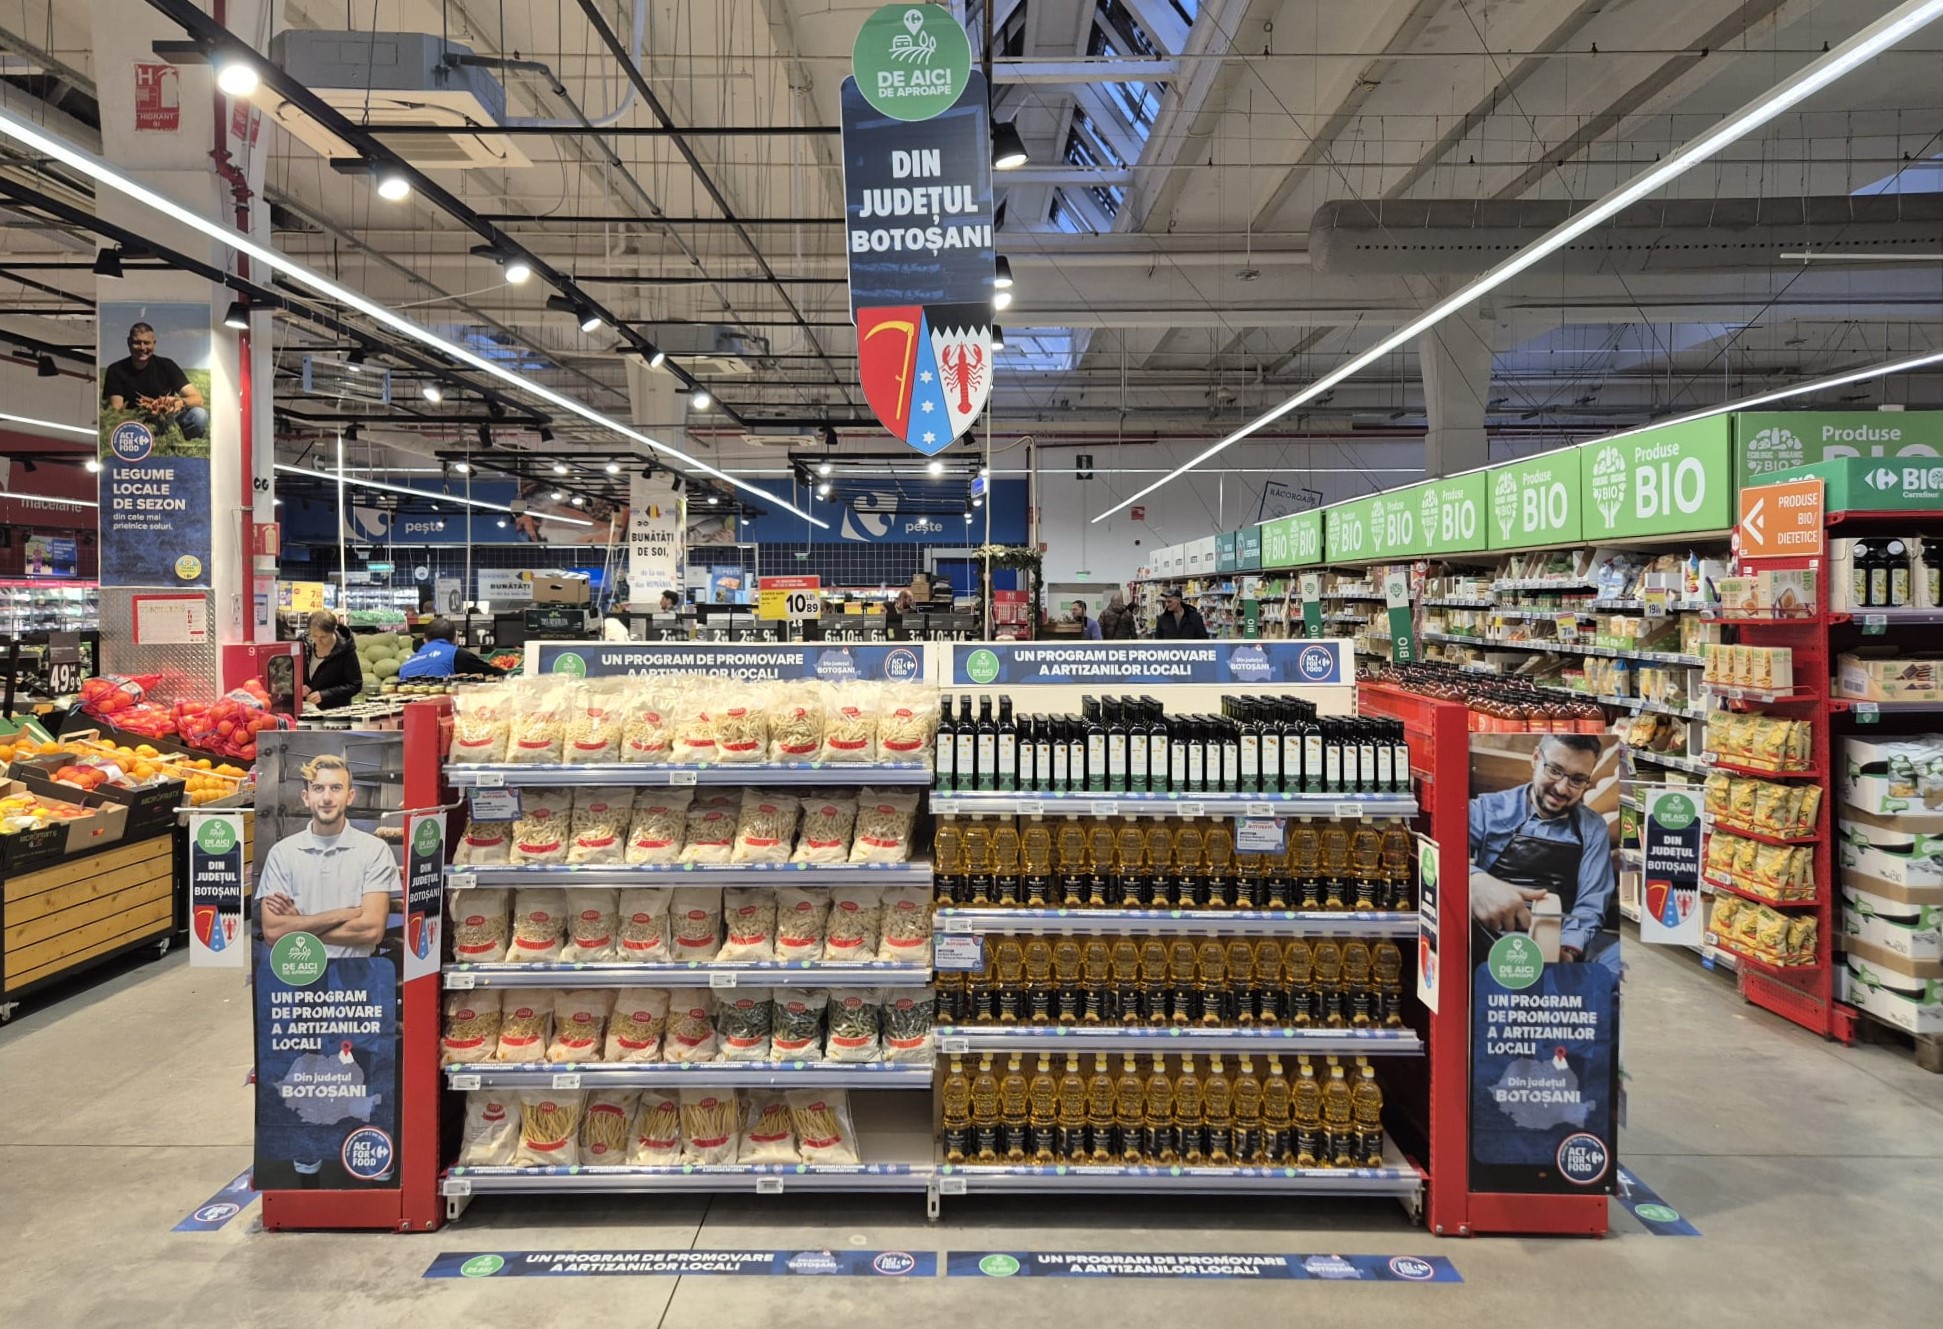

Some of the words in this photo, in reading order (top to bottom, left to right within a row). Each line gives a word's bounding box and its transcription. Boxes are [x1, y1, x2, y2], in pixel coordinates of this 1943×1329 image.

[138, 68, 152, 85] H
[877, 70, 905, 88] DE
[910, 68, 951, 87] AICI
[878, 87, 894, 98] DE
[897, 85, 951, 97] APROAPE
[892, 149, 941, 178] DIN
[859, 185, 978, 225] JUDEȚUL
[851, 225, 992, 257] BOTOȘANI
[1822, 425, 1902, 441] Produse
[1635, 442, 1680, 463] Produse
[113, 469, 174, 480] LEGUME
[1522, 469, 1551, 486] Produse
[113, 484, 170, 495] LOCALE
[1635, 457, 1706, 518] BIO
[1443, 488, 1463, 501] Produse
[1778, 493, 1818, 508] PRODUSE
[113, 498, 133, 510] DE
[137, 498, 186, 510] SEZON
[1523, 482, 1568, 532] BIO
[113, 512, 125, 521] din
[128, 513, 144, 521] cele
[147, 513, 161, 521] mai
[1442, 499, 1475, 541] BIO
[1797, 511, 1817, 526] BIO/
[113, 522, 148, 531] prielnice
[1387, 511, 1413, 547] BIO
[1300, 528, 1316, 556] BIO
[1342, 521, 1363, 552] BIO
[1777, 530, 1818, 545] DIETETICE
[637, 547, 649, 557] DE
[652, 547, 669, 558] SOI,
[1272, 535, 1287, 559] BIO
[786, 594, 806, 613] 10
[806, 603, 818, 613] 89
[248, 647, 256, 656] 9
[1398, 637, 1410, 658] BIO
[602, 654, 622, 665] UN
[625, 654, 694, 665] PROGRAM
[697, 654, 715, 665] DE
[717, 654, 804, 665] PROMOVARE
[1014, 650, 1035, 662] UN
[1037, 650, 1107, 661] PROGRAM
[1108, 650, 1127, 661] DE
[1129, 650, 1217, 661] PROMOVARE
[1039, 665, 1050, 675] A
[1051, 664, 1142, 675] ARTIZANILOR
[1143, 664, 1192, 675] LOCALI
[50, 664, 70, 693] 49
[1663, 835, 1682, 845] DIN
[1650, 846, 1694, 860] JUDEȚUL
[208, 861, 225, 870] DIN
[420, 863, 432, 874] DIN
[1647, 860, 1697, 875] BOTOȘANI
[196, 872, 237, 884] JUDEȚUL
[411, 873, 439, 887] JUDEȚUL
[194, 886, 240, 900] BOTOȘANI
[409, 887, 440, 903] BOTOȘANI
[298, 962, 318, 970] AICI
[1499, 966, 1514, 974] DE
[1516, 966, 1534, 974] AICI
[271, 992, 292, 1003] UN
[295, 990, 367, 1003] PROGRAM
[1488, 995, 1509, 1007] UN
[1511, 995, 1582, 1008] PROGRAM
[271, 1007, 290, 1019] DE
[292, 1005, 383, 1019] PROMOVARE
[1488, 1011, 1506, 1023] DE
[1508, 1011, 1597, 1024] PROMOVARE
[272, 1023, 282, 1035] A
[288, 1021, 380, 1035] ARTIZANILOR
[1488, 1027, 1498, 1039] A
[1503, 1027, 1595, 1040] ARTIZANILOR
[272, 1037, 322, 1050] LOCALI
[1488, 1042, 1536, 1054] LOCALI
[293, 1073, 312, 1082] Din
[313, 1072, 352, 1085] județul
[1508, 1078, 1526, 1087] Din
[1528, 1077, 1566, 1089] județul
[282, 1085, 366, 1102] BOTOȘANI
[1496, 1090, 1581, 1108] BOTOȘANI
[353, 1141, 371, 1150] ACT
[1568, 1147, 1586, 1156] ACT
[353, 1150, 370, 1159] FOR
[1568, 1155, 1585, 1164] FOR
[352, 1158, 377, 1167] FOOD
[1568, 1163, 1592, 1172] FOOD
[526, 1254, 551, 1263] UN
[549, 1253, 639, 1263] PROGRAM
[641, 1253, 666, 1262] DE
[667, 1253, 775, 1262] PROMOVARE
[1038, 1255, 1064, 1263] UN
[1065, 1255, 1152, 1264] PROGRAM
[1153, 1256, 1178, 1265] DE
[1178, 1256, 1287, 1266] PROMOVARE
[549, 1263, 563, 1272] A
[563, 1263, 679, 1272] ARTIZANILOR
[682, 1262, 740, 1271] LOCALI
[1070, 1264, 1083, 1273] A
[1085, 1264, 1198, 1274] ARTIZANILOR
[1199, 1266, 1260, 1275] LOCALI
